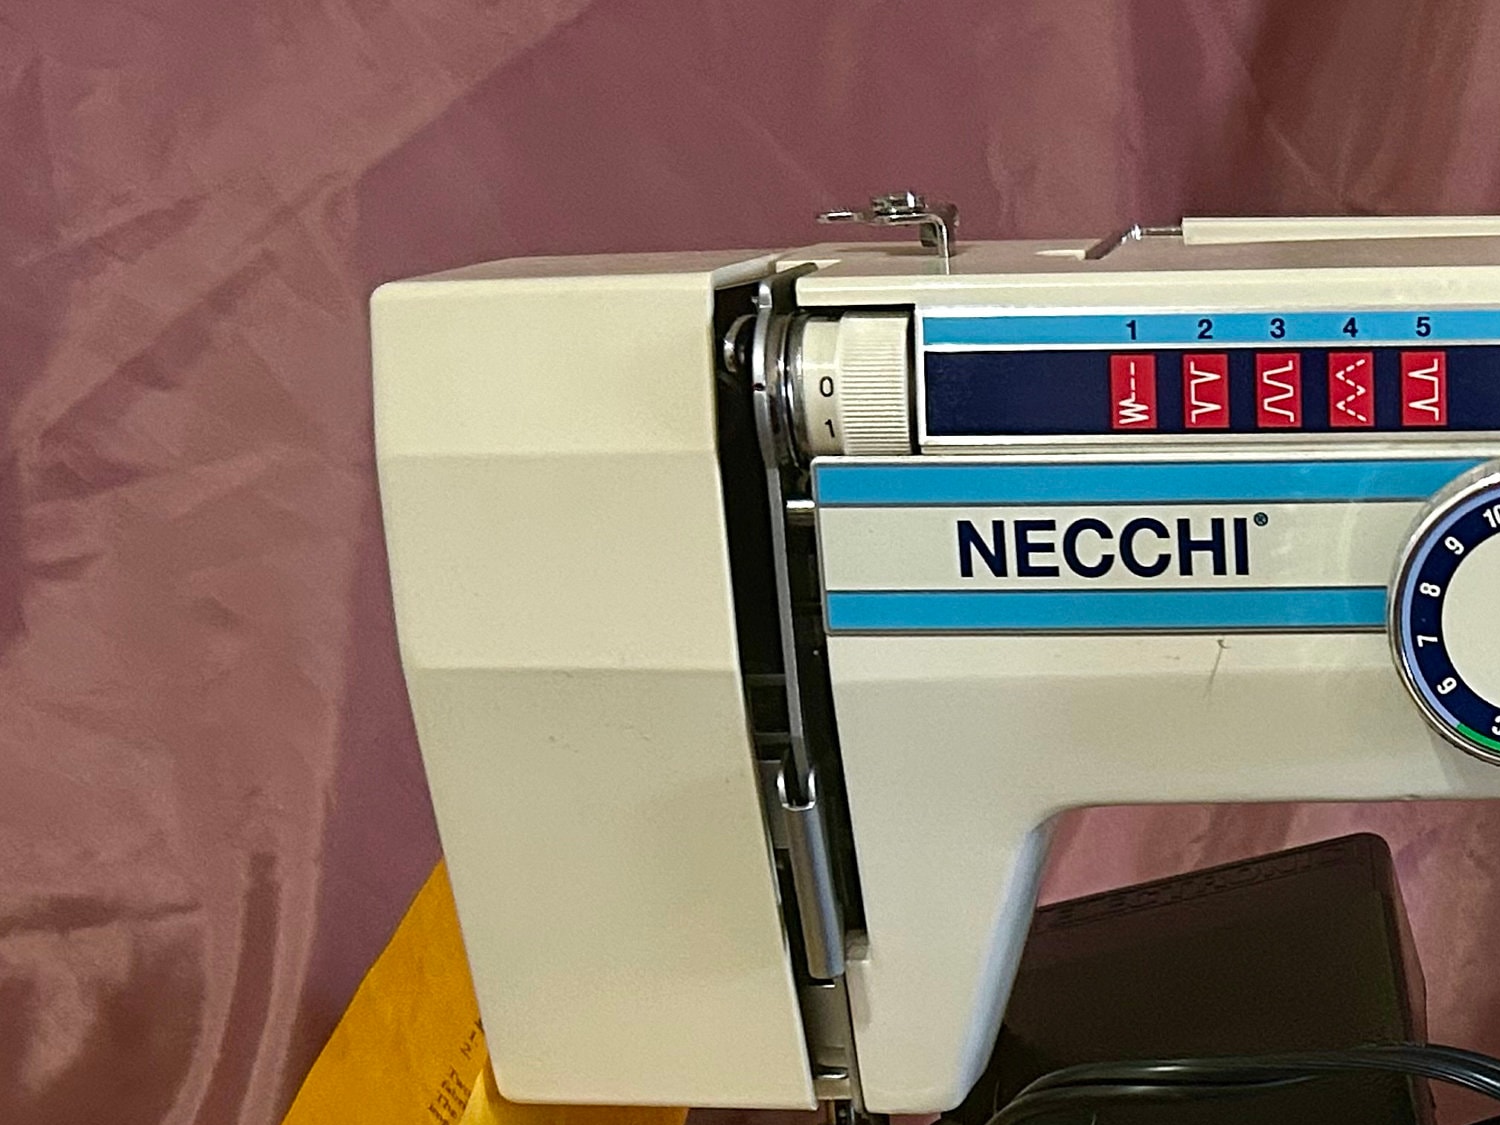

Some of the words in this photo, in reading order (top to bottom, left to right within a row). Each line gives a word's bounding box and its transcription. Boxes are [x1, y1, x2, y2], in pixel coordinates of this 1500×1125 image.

[1126, 320, 1138, 340] 1
[1198, 319, 1213, 340] 2
[1269, 318, 1286, 339] 3
[1342, 317, 1359, 338] 4
[1415, 316, 1432, 337] 5
[820, 375, 834, 397] 0
[824, 418, 835, 438] 1
[1443, 535, 1465, 556] 9
[1419, 581, 1442, 598] 8
[1416, 634, 1438, 648] 7
[1436, 676, 1458, 695] 6
